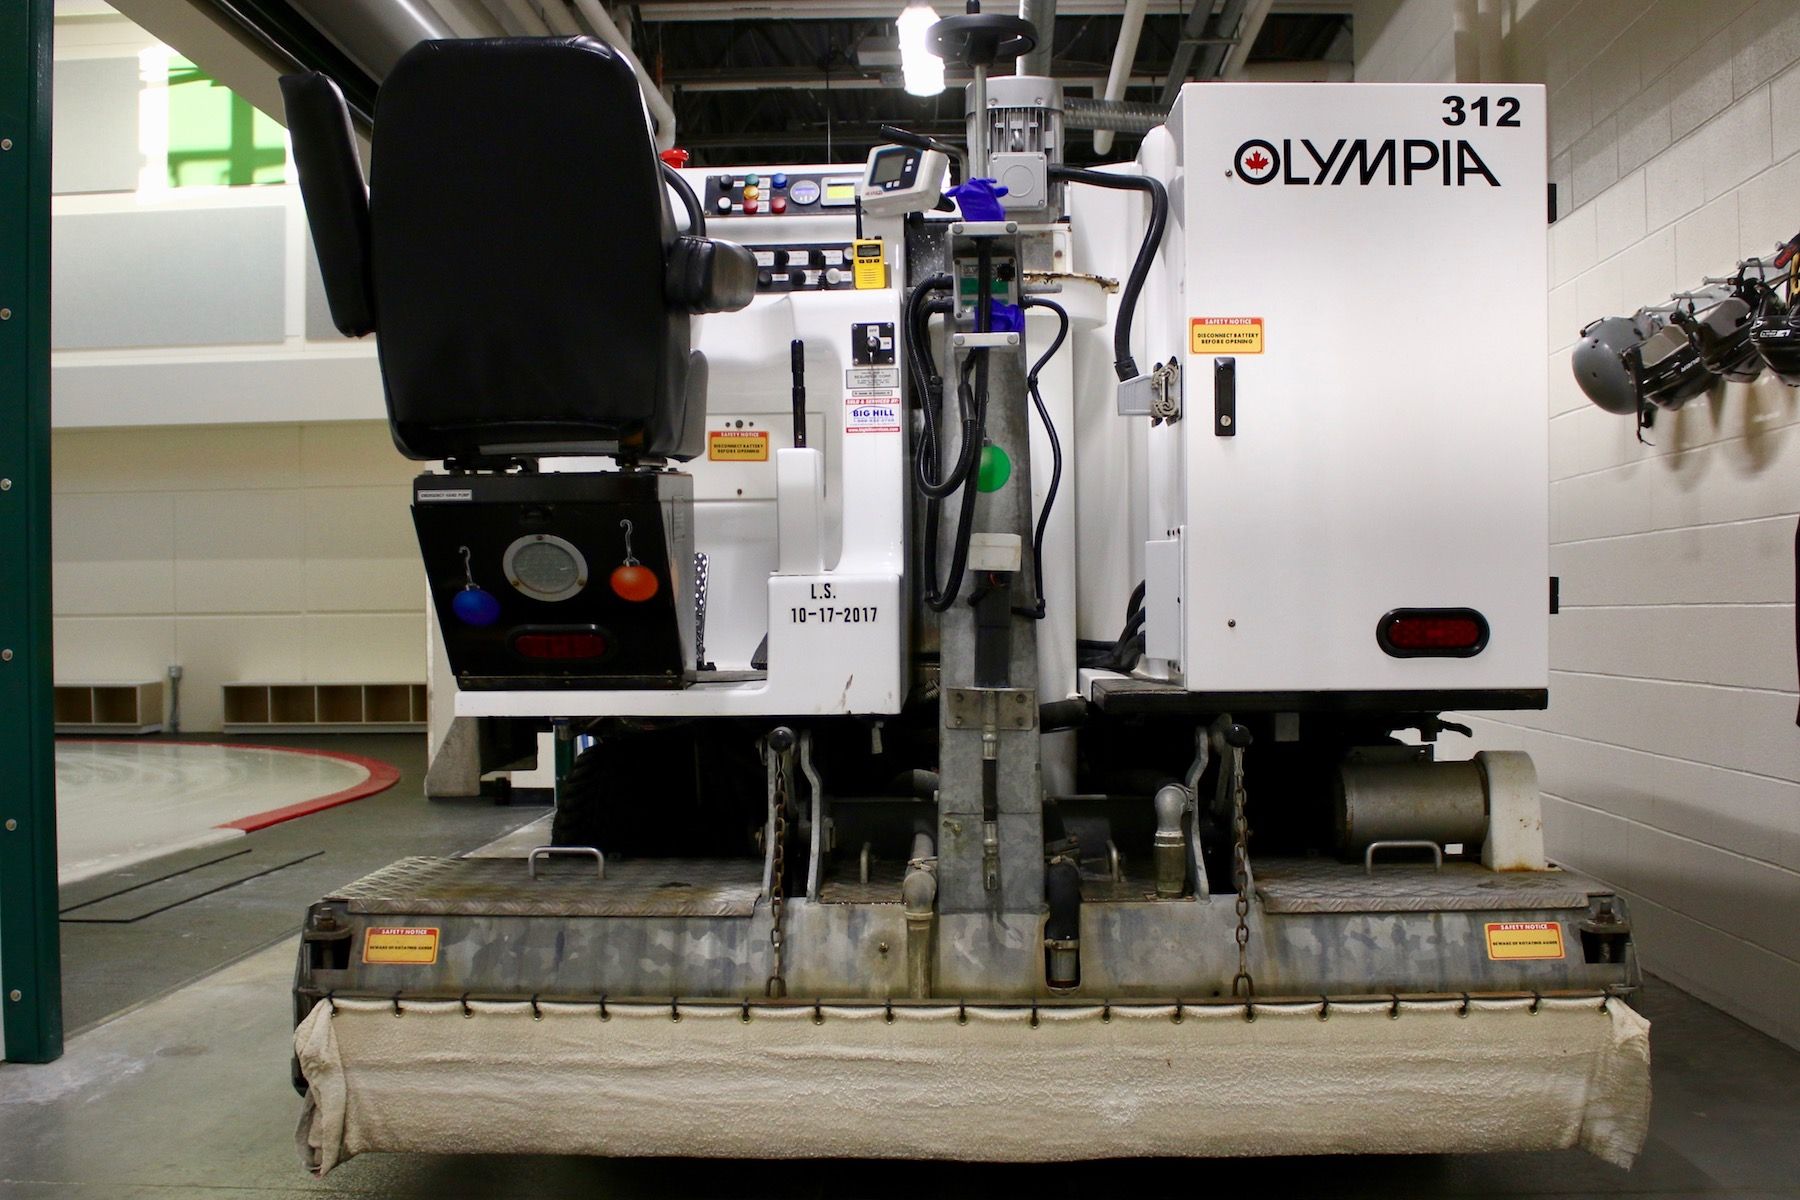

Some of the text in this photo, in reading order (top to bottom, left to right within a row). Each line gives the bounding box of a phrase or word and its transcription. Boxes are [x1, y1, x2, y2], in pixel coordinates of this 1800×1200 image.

[1442, 95, 1521, 127] 312
[1234, 138, 1502, 187] OLYMPIA
[853, 409, 871, 417] BIG
[811, 583, 836, 599] L.S.
[791, 607, 877, 623] 10-17-2017
